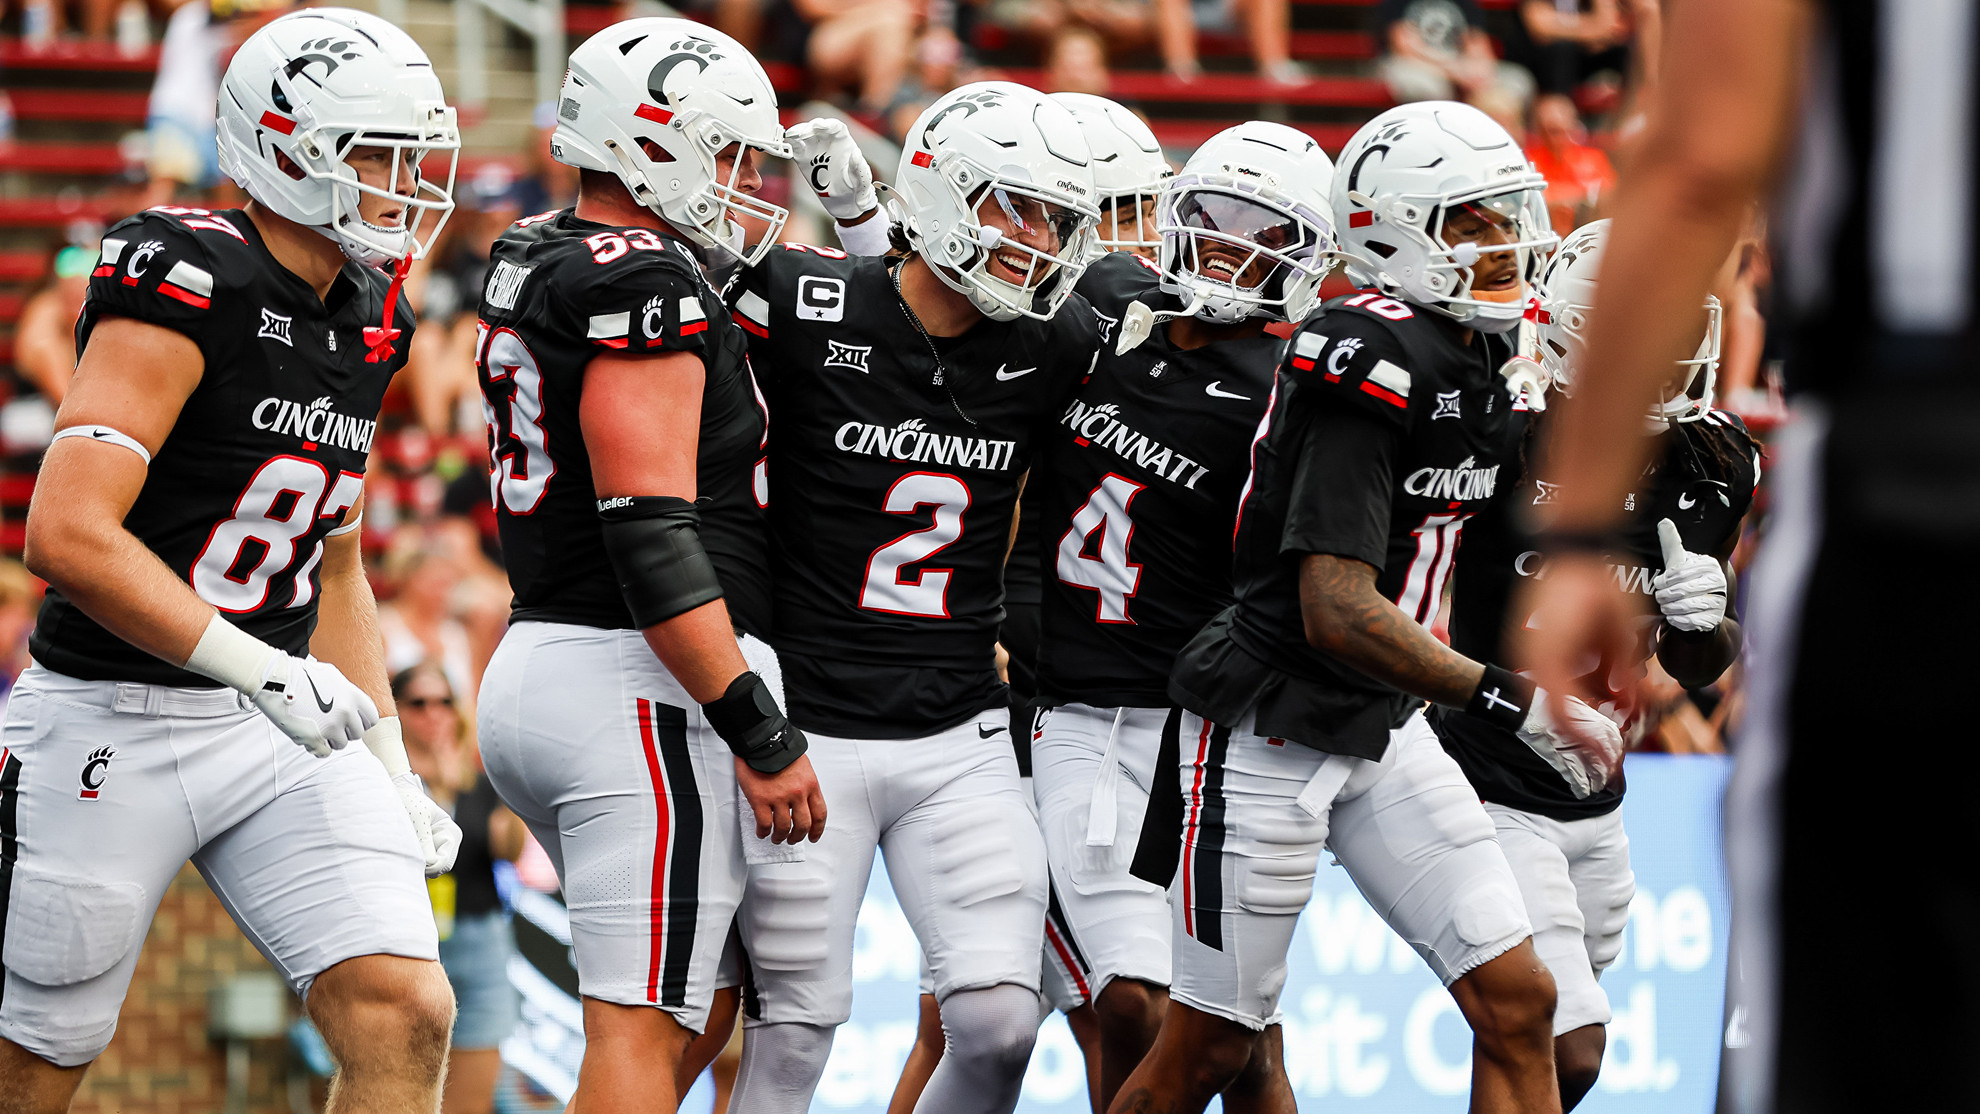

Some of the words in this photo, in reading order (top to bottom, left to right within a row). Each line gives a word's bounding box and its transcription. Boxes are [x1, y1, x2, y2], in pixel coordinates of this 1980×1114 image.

[580, 229, 664, 265] 53
[802, 279, 840, 309] C
[1343, 292, 1415, 321] 10
[932, 376, 943, 386] 58
[252, 397, 377, 453] CINCINNAT
[834, 418, 1016, 471] CINCINNATI
[1060, 399, 1210, 490] NCINNATI
[1624, 502, 1636, 511] 58
[1625, 493, 1636, 502] JK
[190, 454, 364, 614] 87
[858, 471, 972, 619] 2
[1056, 471, 1148, 625] 4
